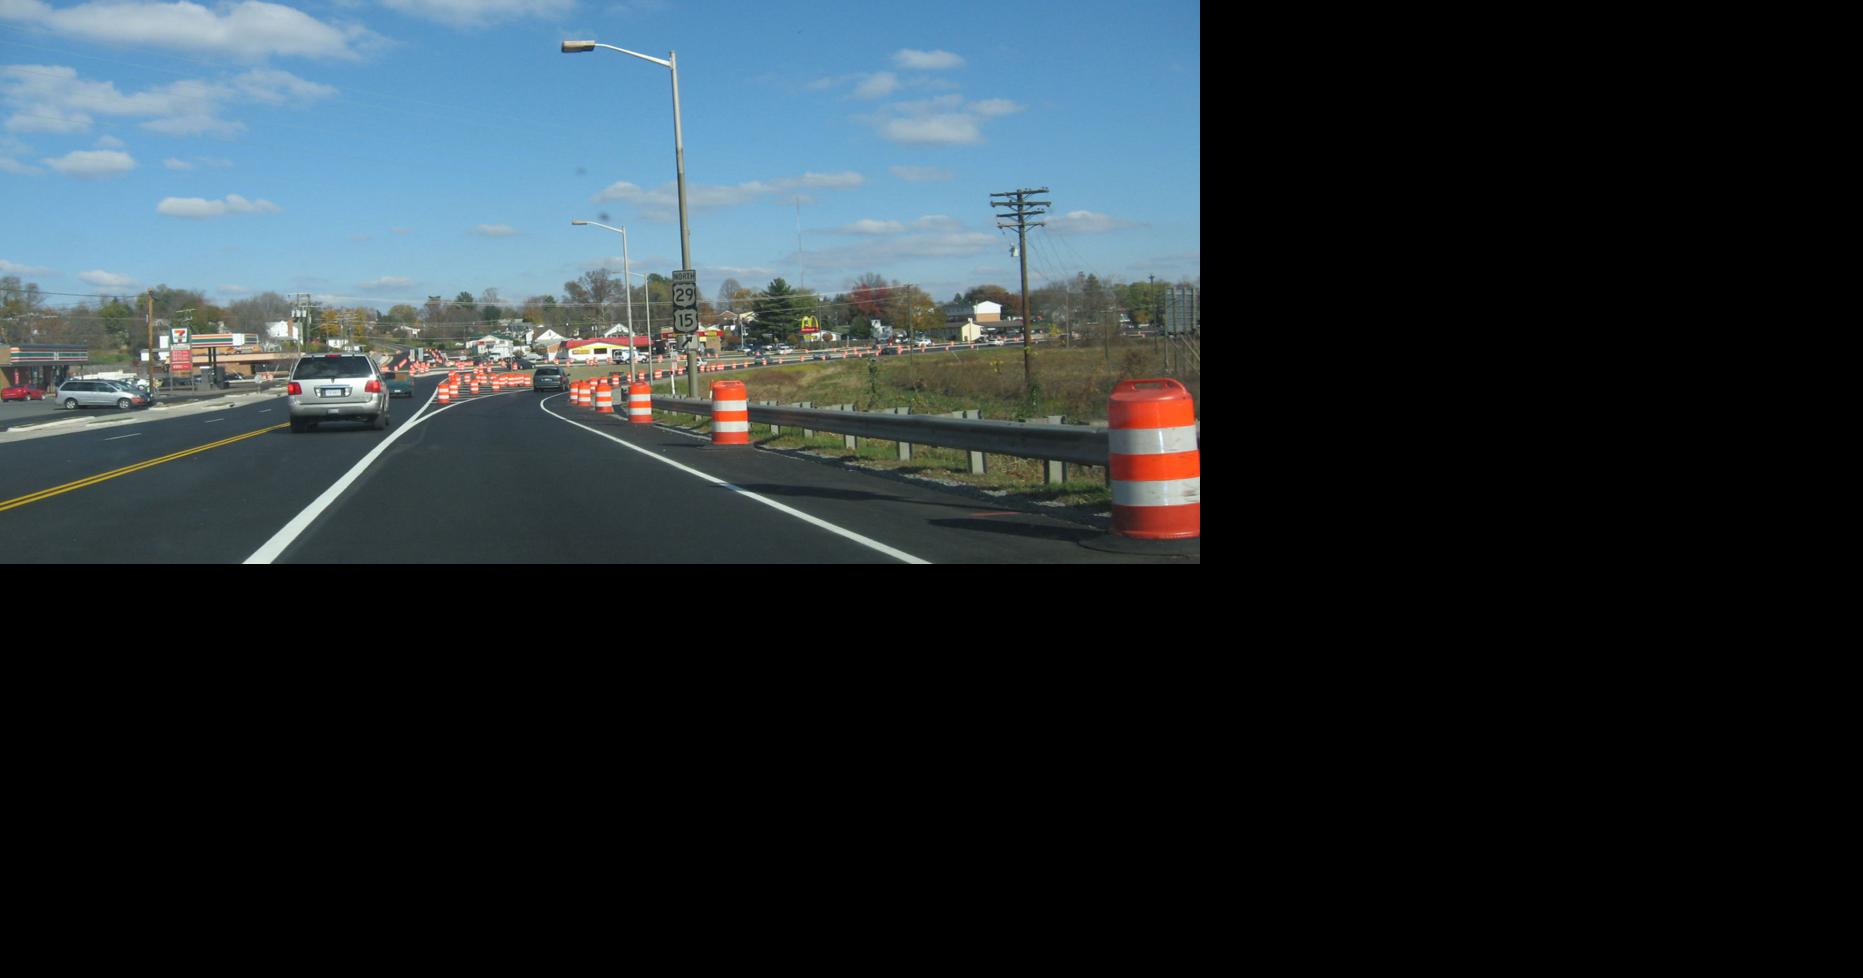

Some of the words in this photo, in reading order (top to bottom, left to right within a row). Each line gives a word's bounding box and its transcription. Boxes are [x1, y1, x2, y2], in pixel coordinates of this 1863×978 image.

[673, 273, 696, 281] NORTH
[676, 288, 694, 302] 29
[679, 313, 694, 328] 15
